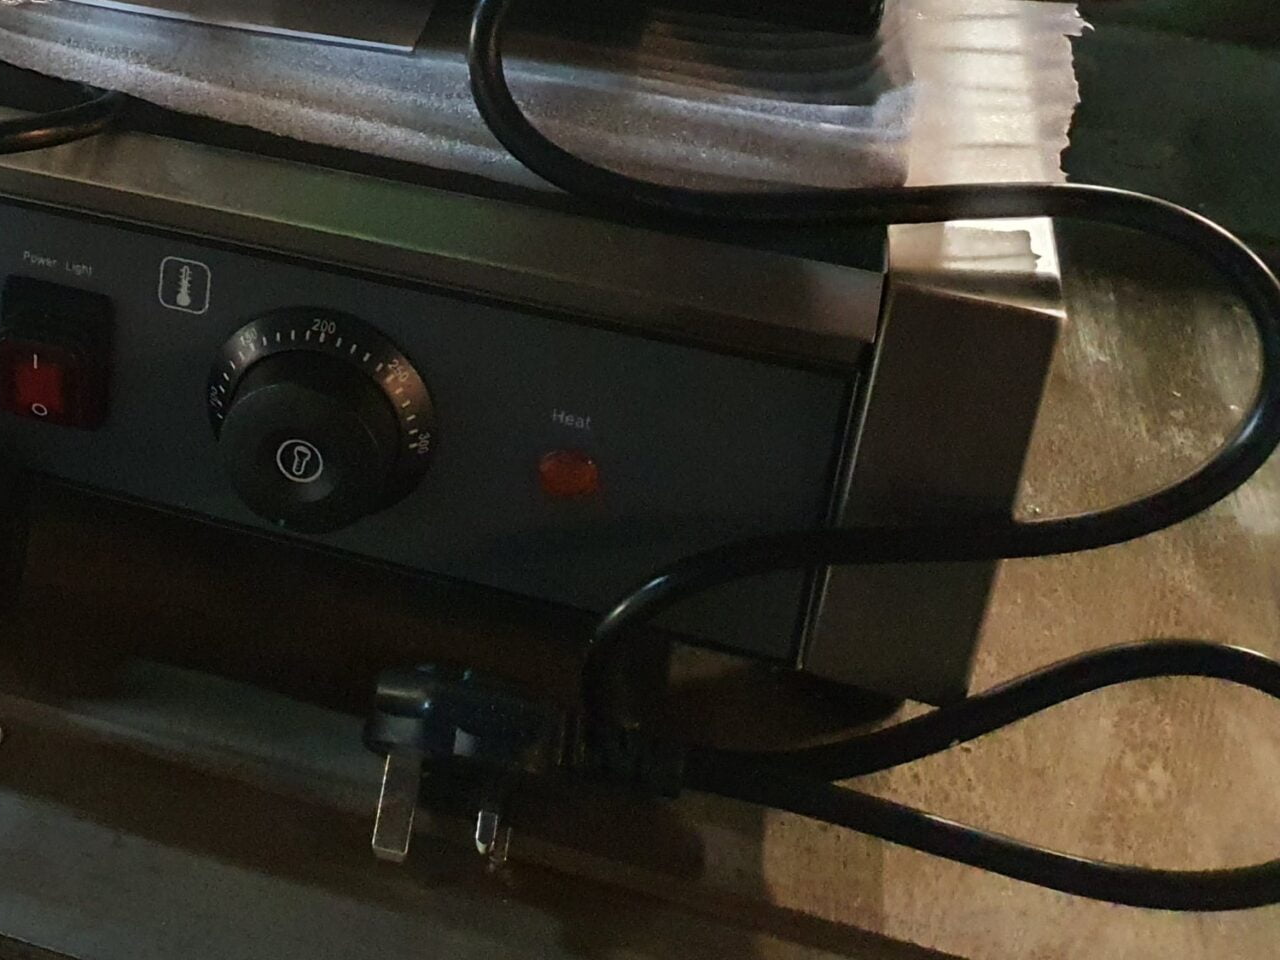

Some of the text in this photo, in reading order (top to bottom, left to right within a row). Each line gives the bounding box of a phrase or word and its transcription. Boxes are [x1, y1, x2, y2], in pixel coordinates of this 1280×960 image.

[23, 250, 93, 277] Power Light
[311, 319, 336, 335] 200
[388, 358, 409, 383] 250
[552, 408, 591, 431] Heat
[417, 431, 431, 455] 300
